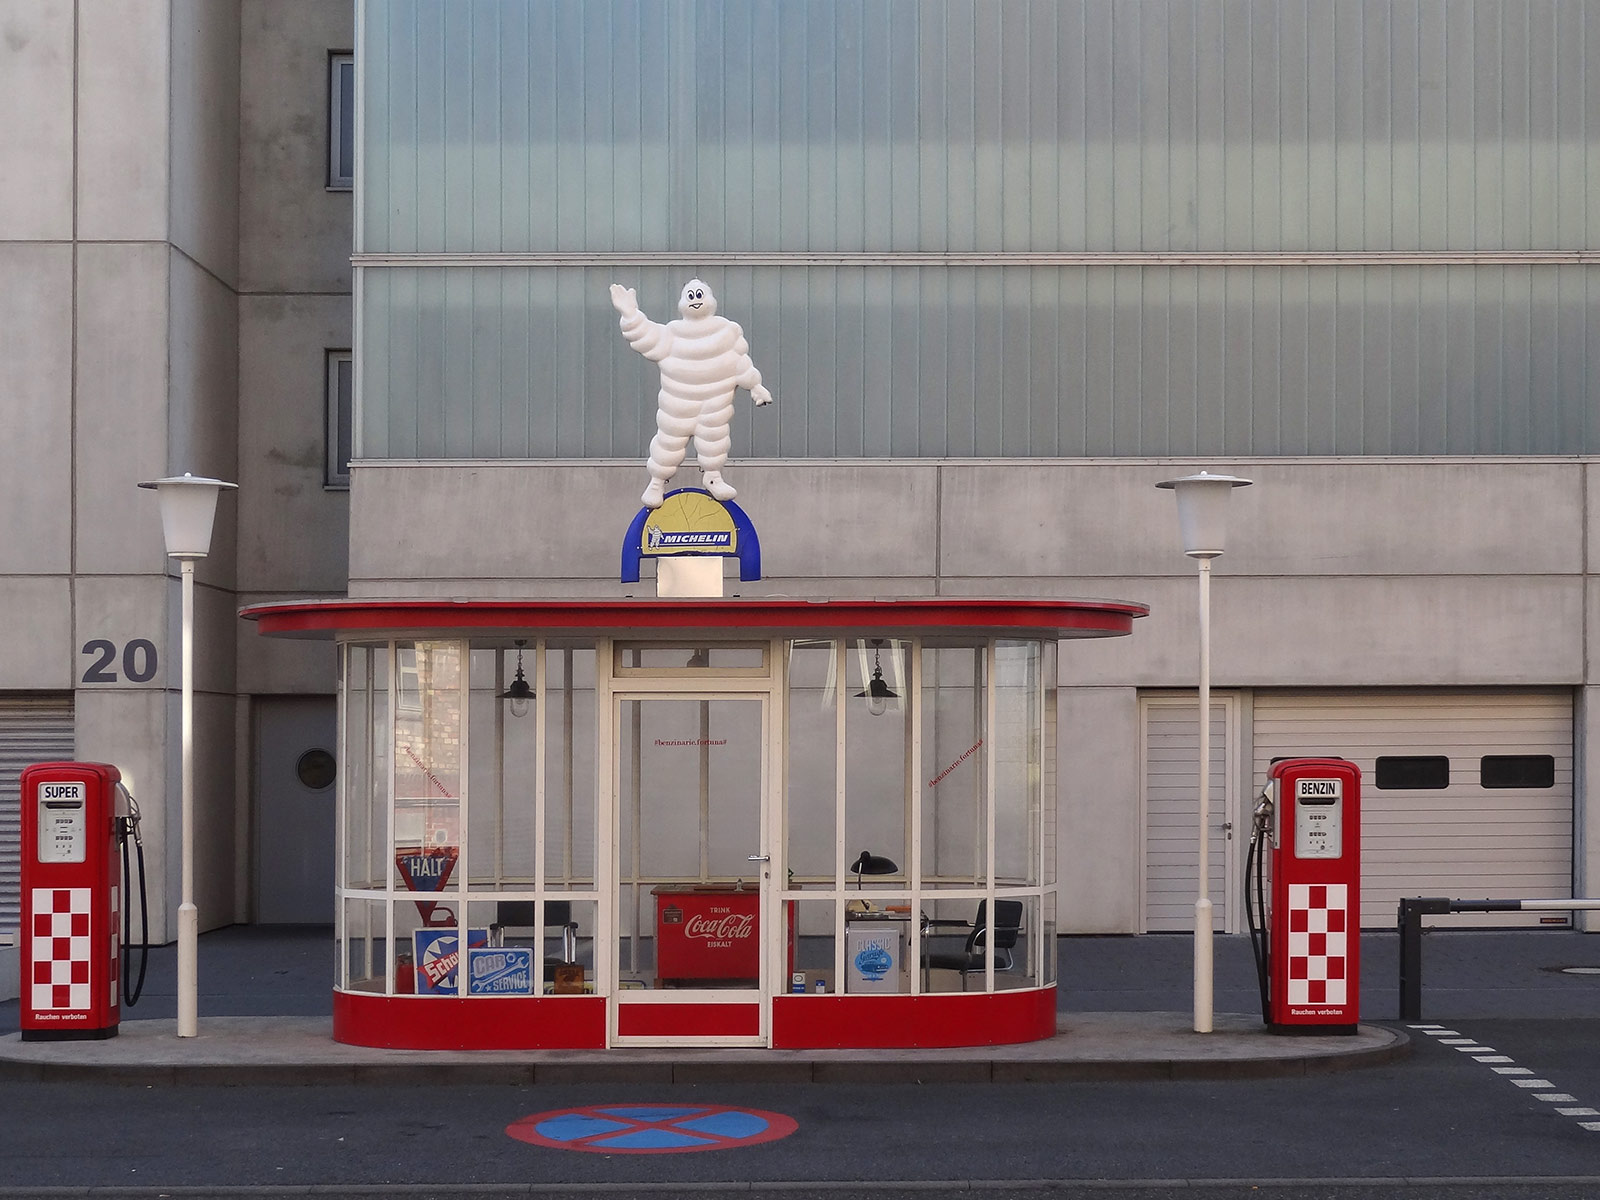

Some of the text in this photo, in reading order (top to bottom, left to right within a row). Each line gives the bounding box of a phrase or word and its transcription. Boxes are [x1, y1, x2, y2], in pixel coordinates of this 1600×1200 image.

[664, 534, 728, 543] MICHELIN
[82, 638, 158, 683] 20
[45, 786, 79, 798] SUPER
[1301, 782, 1336, 795] BENZIN
[410, 856, 445, 877] HALT
[684, 914, 756, 939] Coca-Cola
[857, 938, 891, 952] CLASSIC
[474, 955, 506, 978] CAR
[493, 971, 528, 991] SERVICE
